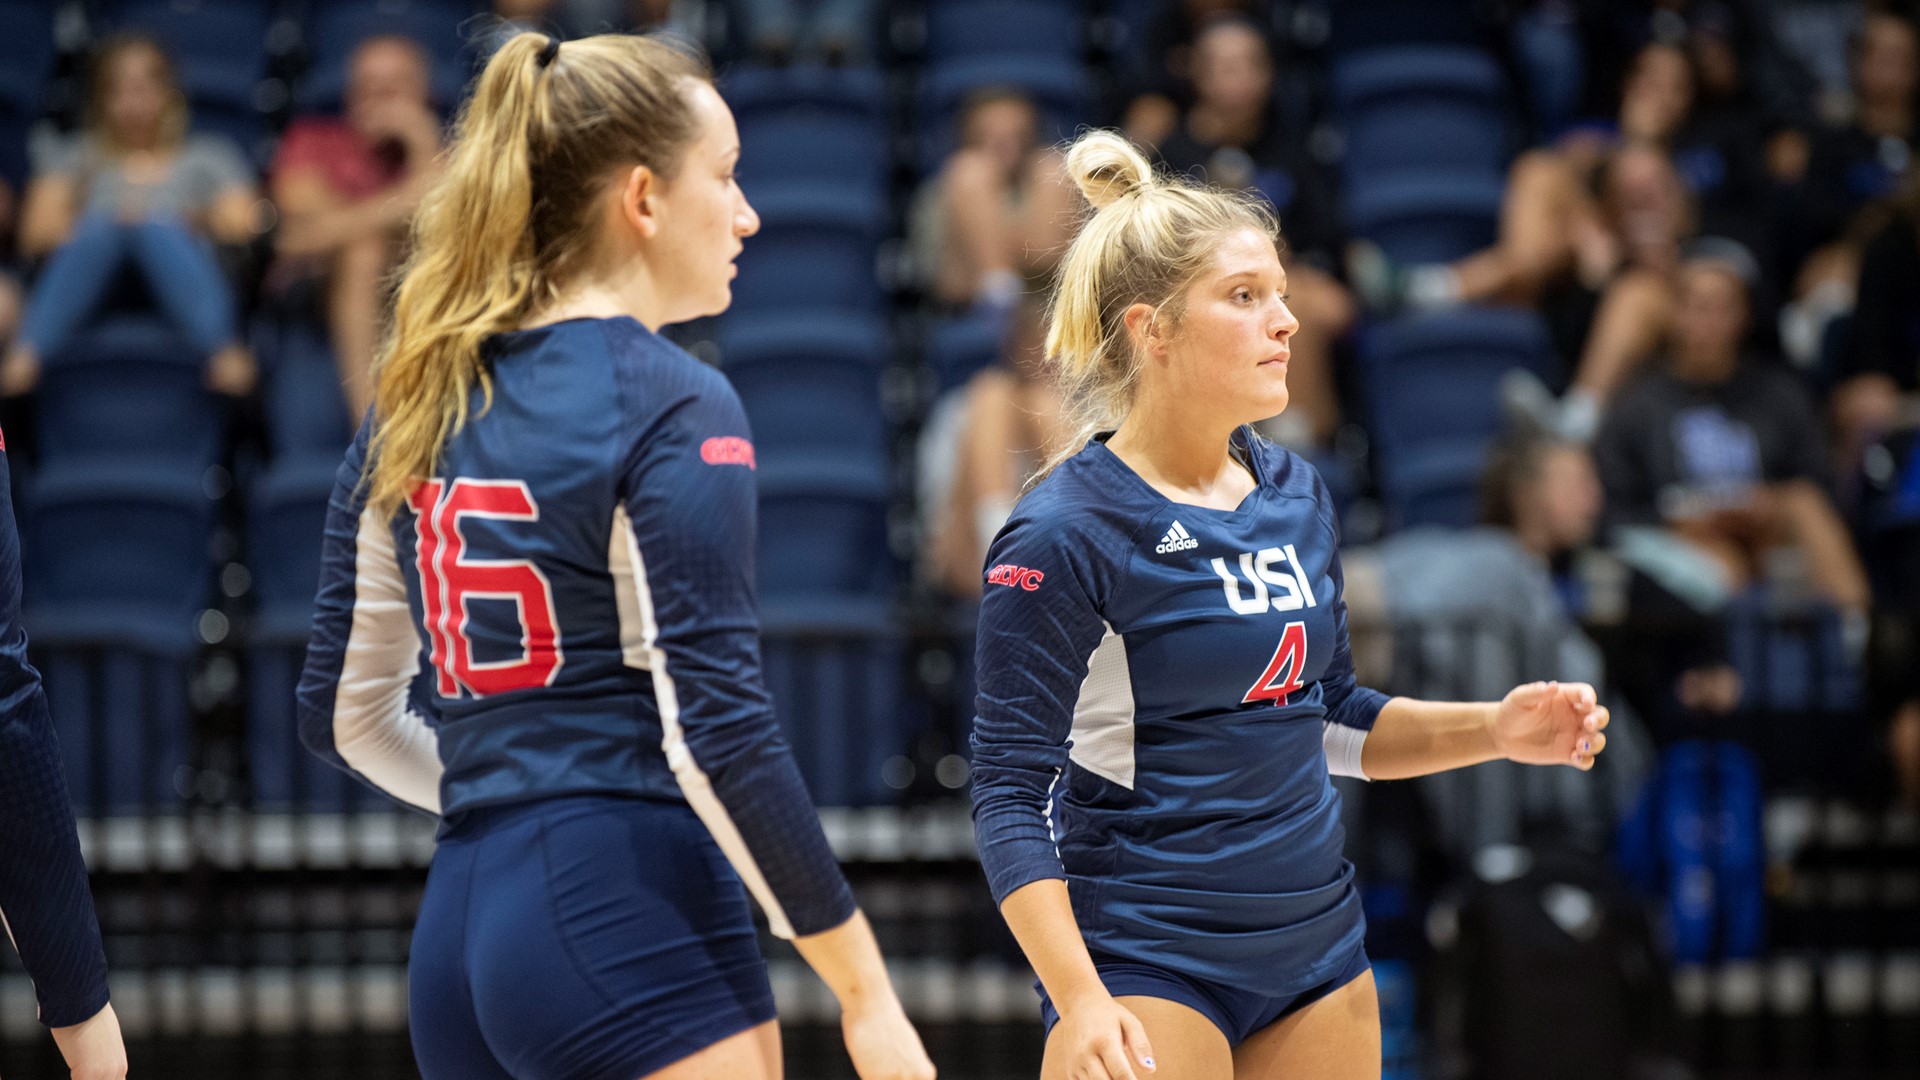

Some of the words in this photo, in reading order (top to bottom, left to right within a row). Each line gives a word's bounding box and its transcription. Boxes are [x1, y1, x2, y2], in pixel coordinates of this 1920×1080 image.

[1156, 538, 1199, 554] adidas
[1210, 544, 1317, 615] USI
[402, 476, 565, 699] 16
[1241, 621, 1307, 706] 4
